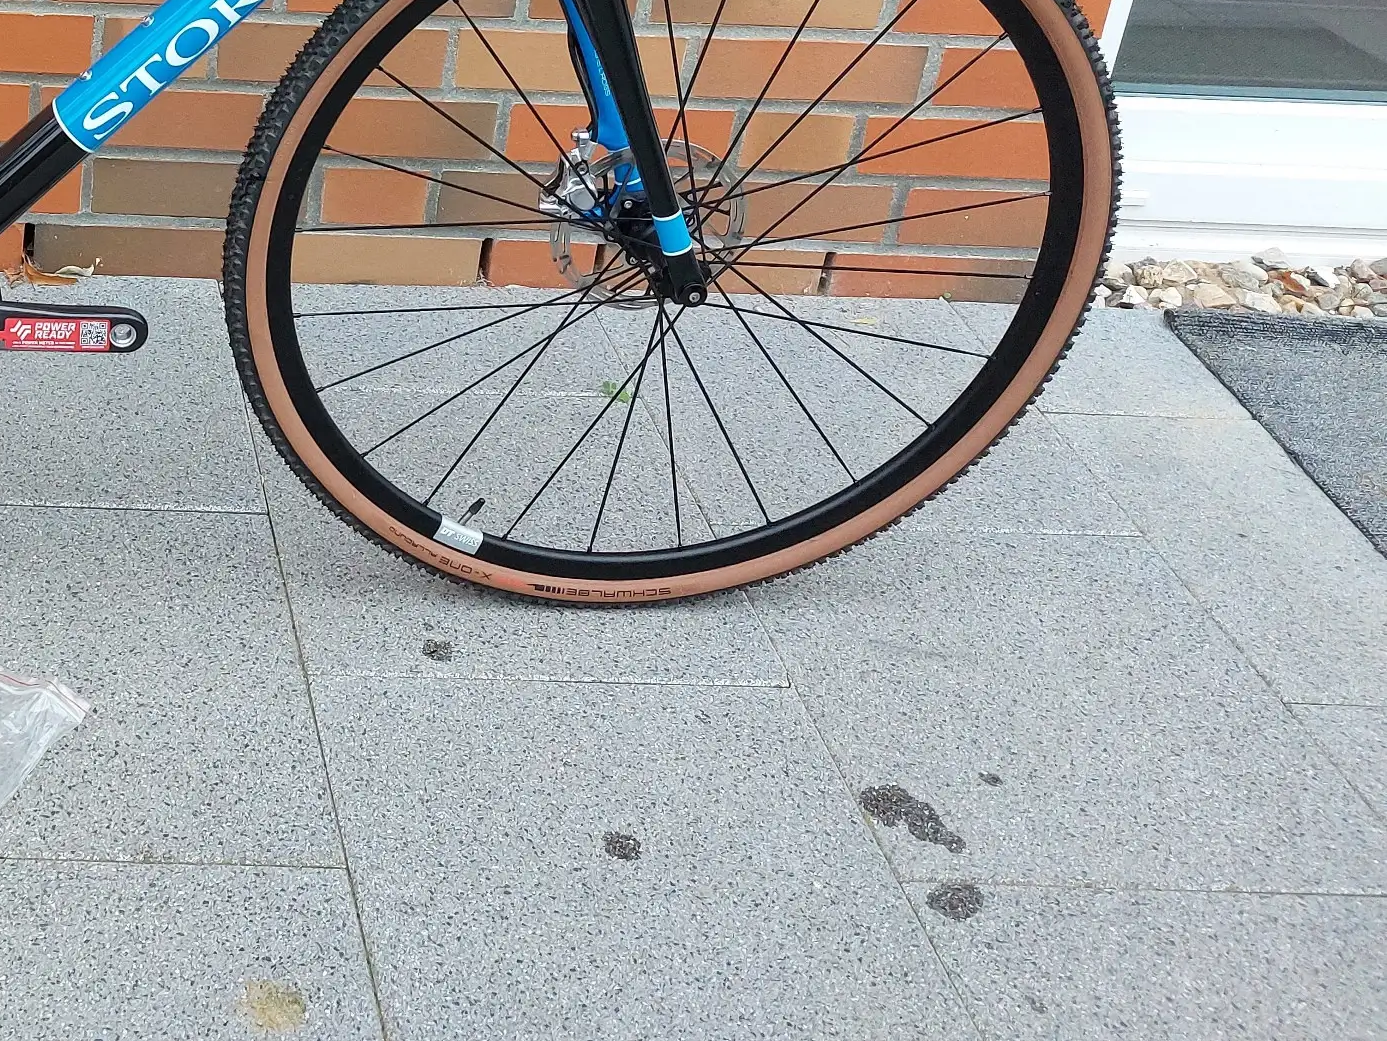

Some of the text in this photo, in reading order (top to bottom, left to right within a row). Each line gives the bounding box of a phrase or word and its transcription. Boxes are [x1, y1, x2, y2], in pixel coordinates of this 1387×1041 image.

[34, 322, 76, 331] POWER
[33, 329, 73, 340] READY
[439, 526, 480, 548] DT SWISS
[565, 587, 672, 598] SCHWALBE
